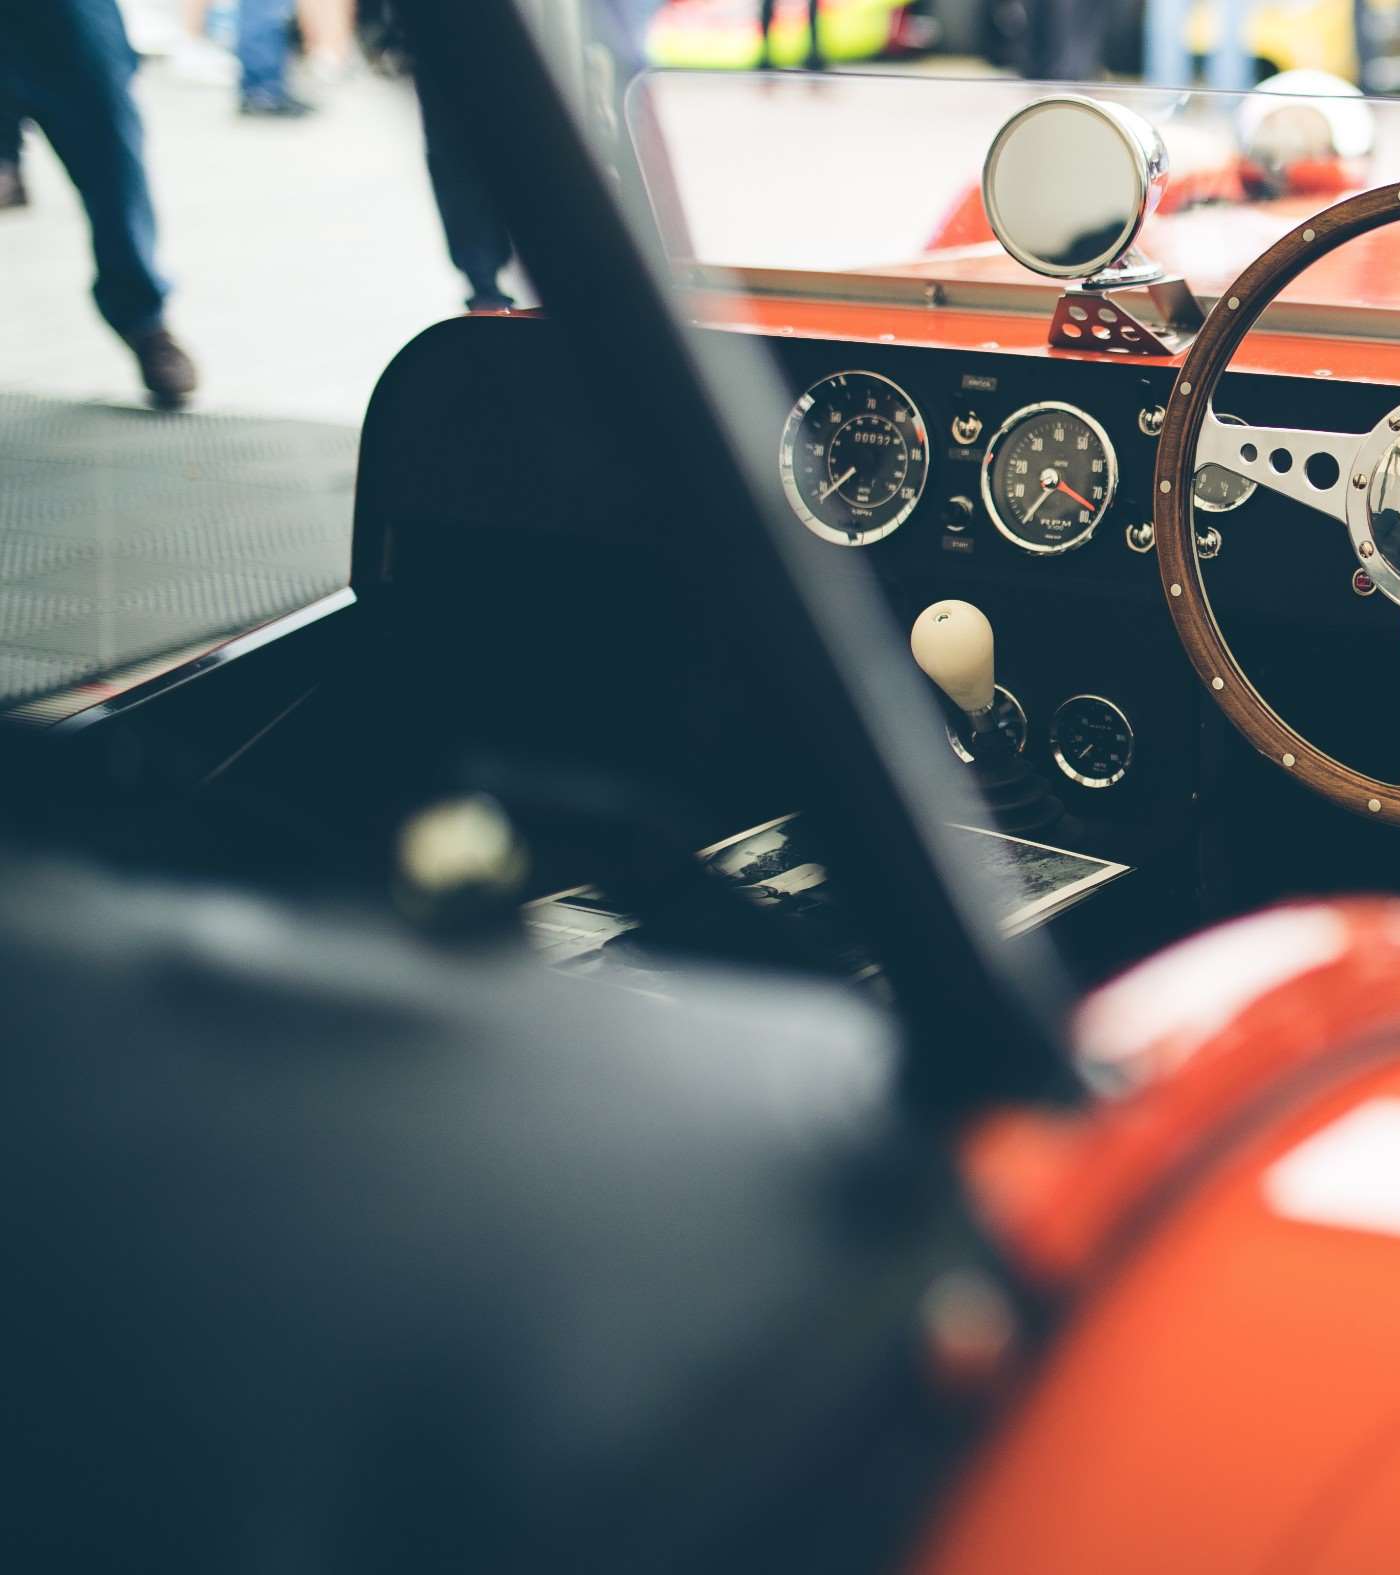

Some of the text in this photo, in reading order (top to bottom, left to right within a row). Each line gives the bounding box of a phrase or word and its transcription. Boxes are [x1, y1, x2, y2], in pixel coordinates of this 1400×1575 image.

[866, 398, 876, 409] 70
[1054, 428, 1065, 442] 40
[1032, 438, 1043, 451] 30
[1077, 436, 1089, 450] 50
[1016, 460, 1028, 474] 20
[1092, 459, 1103, 473] 60
[1015, 483, 1025, 498] 10
[1093, 486, 1103, 500] 70
[1040, 519, 1072, 528] RPM
